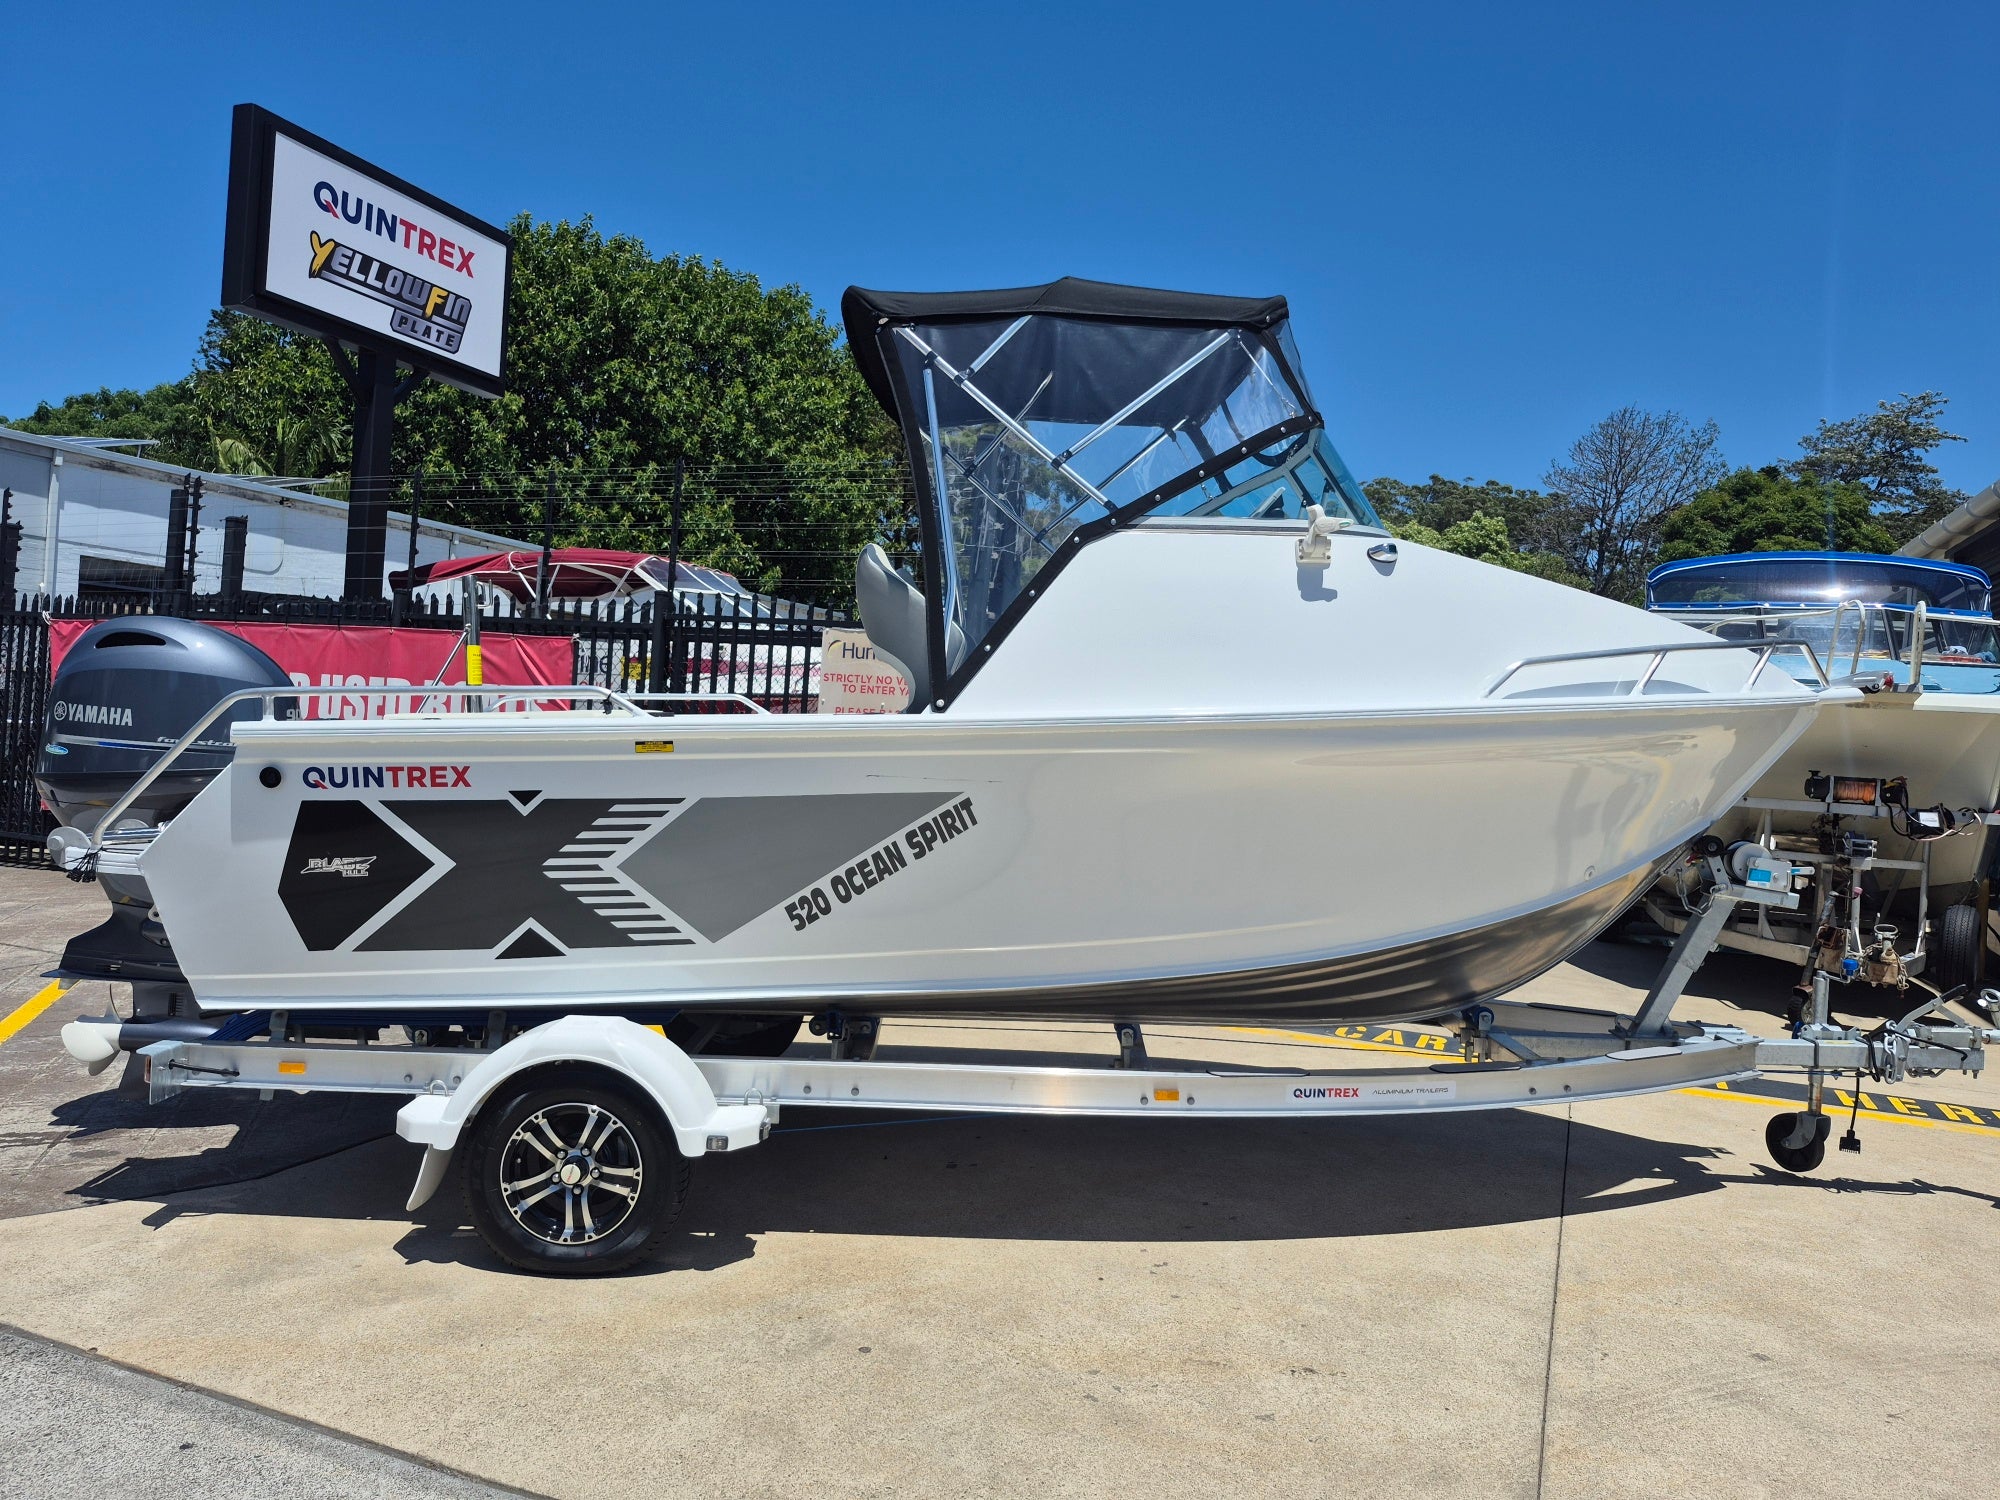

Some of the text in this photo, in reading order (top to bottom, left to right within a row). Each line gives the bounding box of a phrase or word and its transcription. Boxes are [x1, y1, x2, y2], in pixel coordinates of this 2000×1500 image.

[313, 180, 475, 279] QUINTREX
[398, 315, 457, 348] PLATE
[823, 673, 873, 684] STRICTLY
[876, 676, 893, 685] NO
[842, 684, 857, 694] TO
[860, 685, 896, 696] ENTER
[68, 703, 133, 727] YAMAHA
[302, 766, 472, 790] QUINTREX
[304, 856, 374, 873] BLADE
[784, 796, 978, 932] 520 OCEAN SPIRIT
[1293, 1087, 1360, 1099] QUINTREX
[1372, 1088, 1414, 1096] ALUMINIUM
[1834, 1089, 2000, 1125] HER
